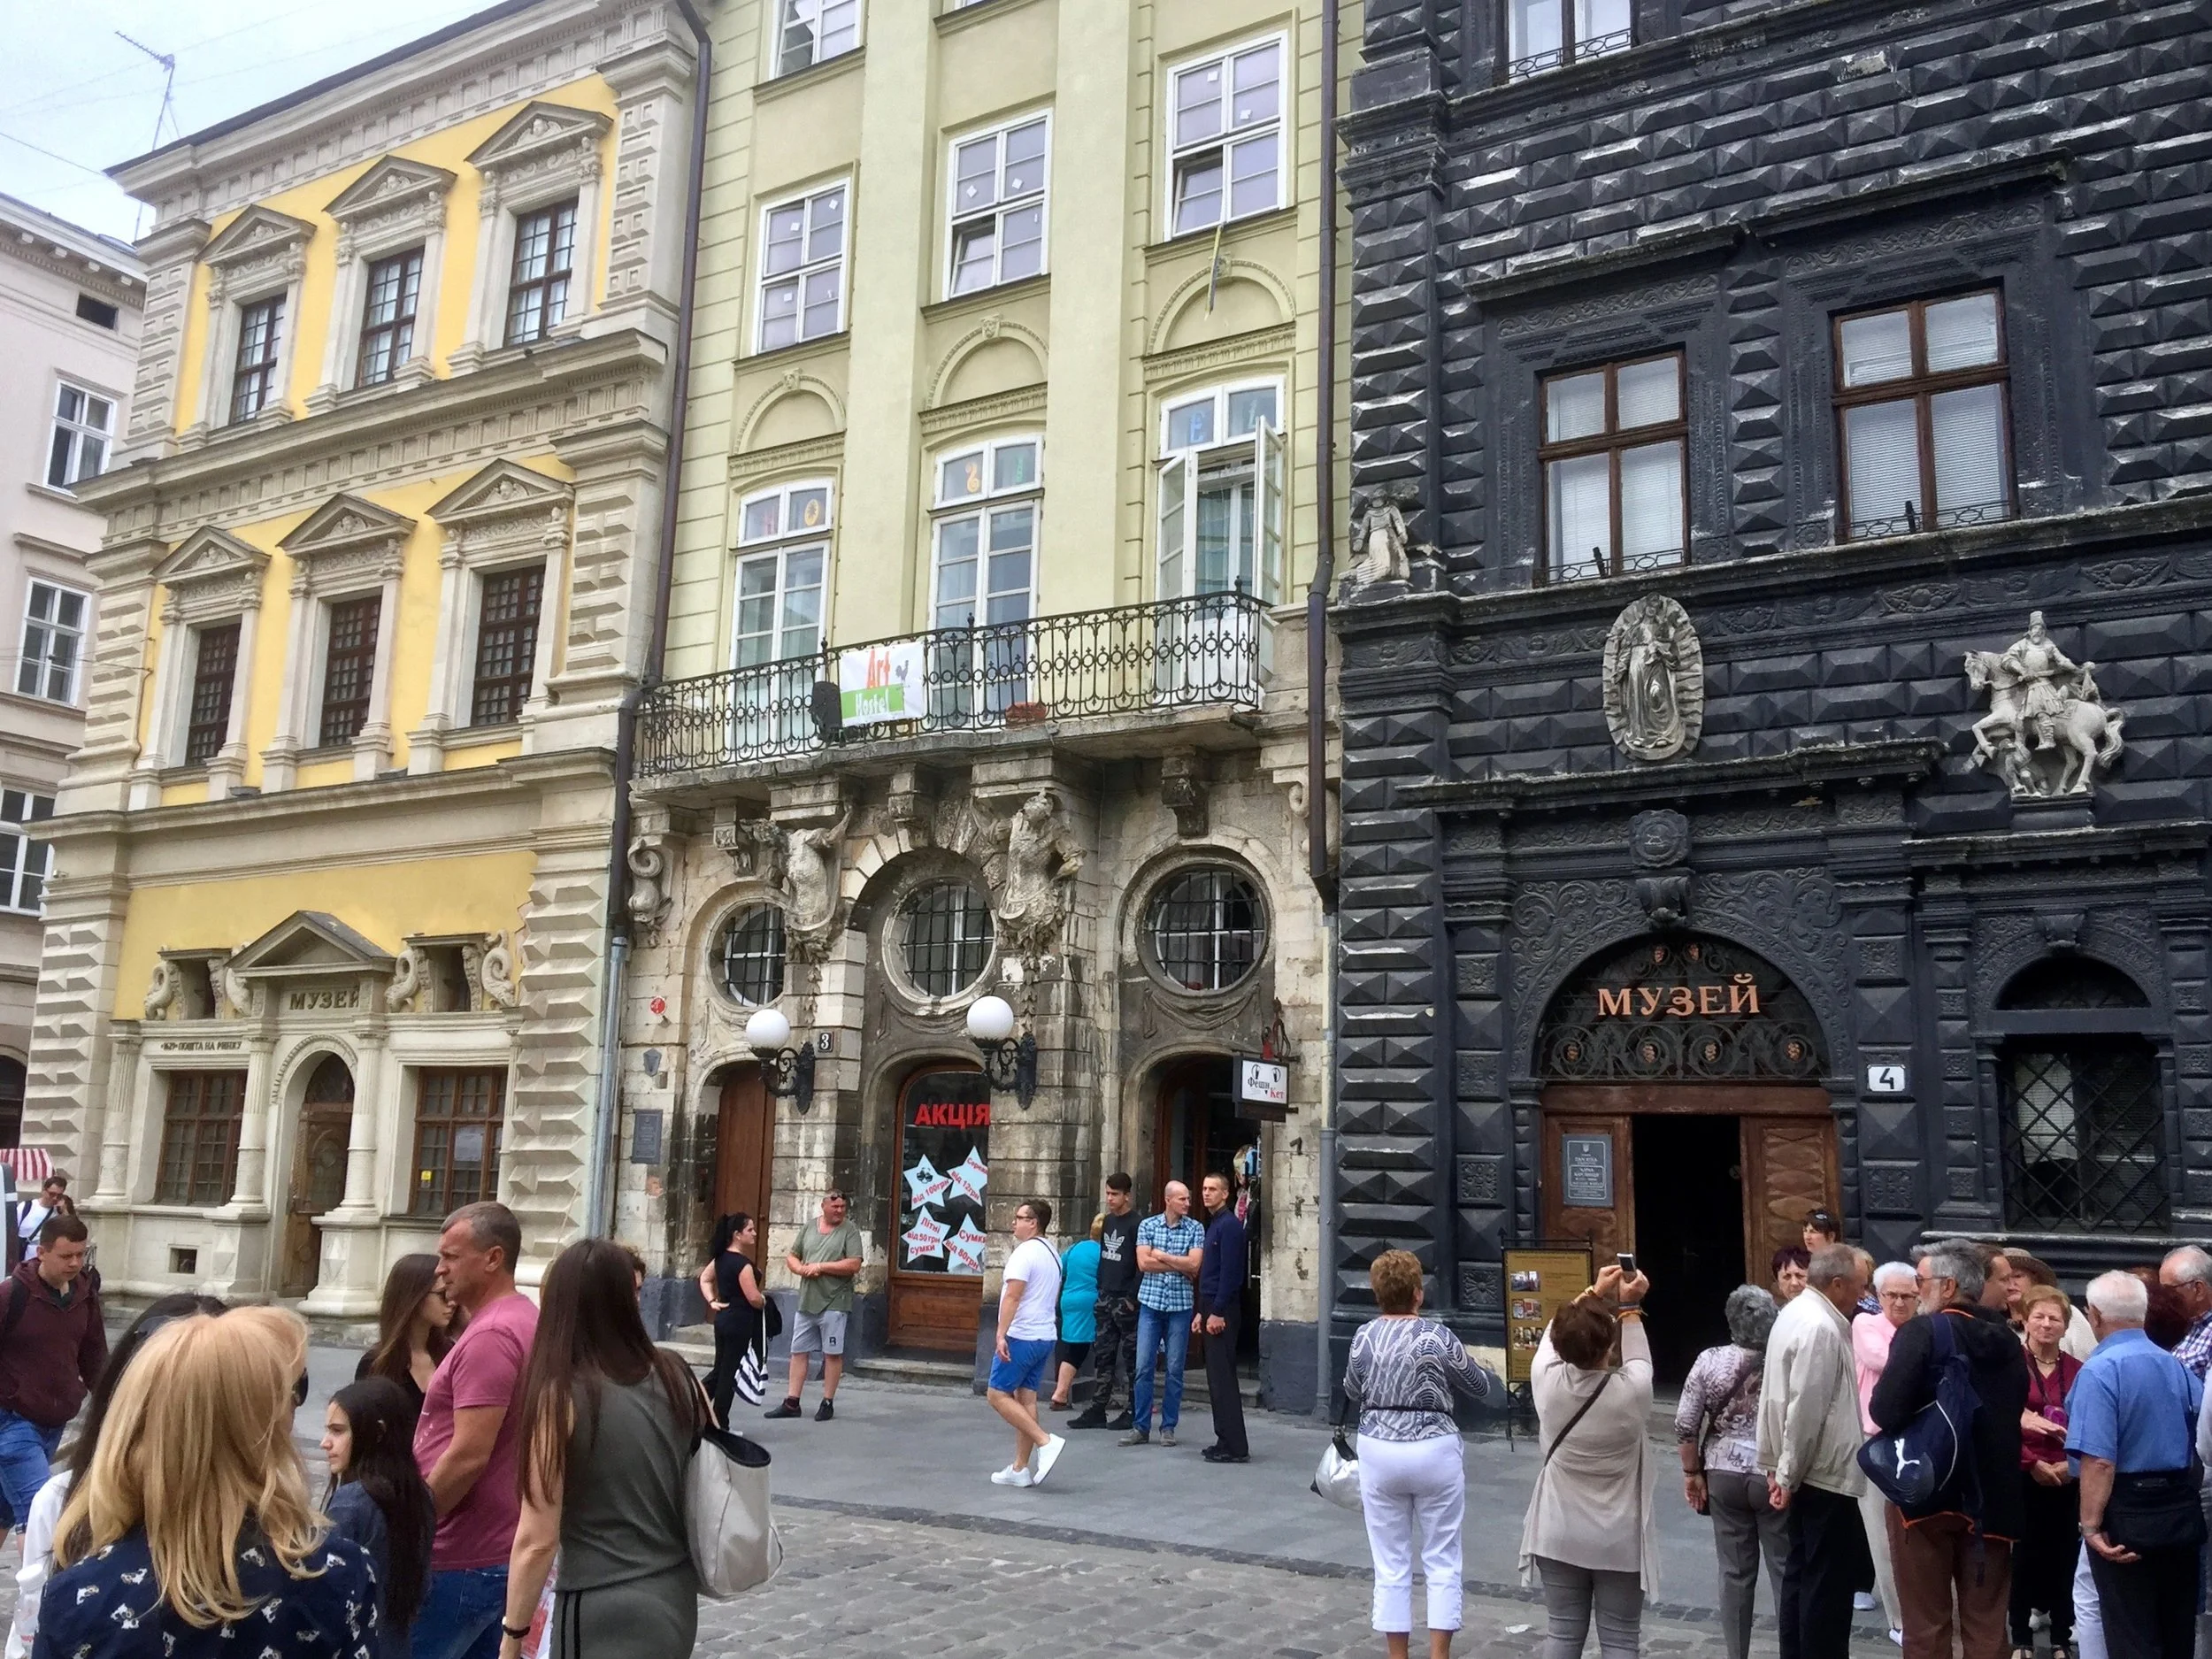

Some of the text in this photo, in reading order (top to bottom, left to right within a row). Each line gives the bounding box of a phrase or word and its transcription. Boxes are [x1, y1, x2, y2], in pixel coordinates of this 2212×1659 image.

[867, 647, 890, 689] Art
[856, 687, 889, 718] Hostel
[1598, 973, 1760, 1016] МУЗЕЙ
[821, 1033, 829, 1049] 3
[1879, 1068, 1894, 1089] 4
[914, 1103, 990, 1130] АКЦІЯ
